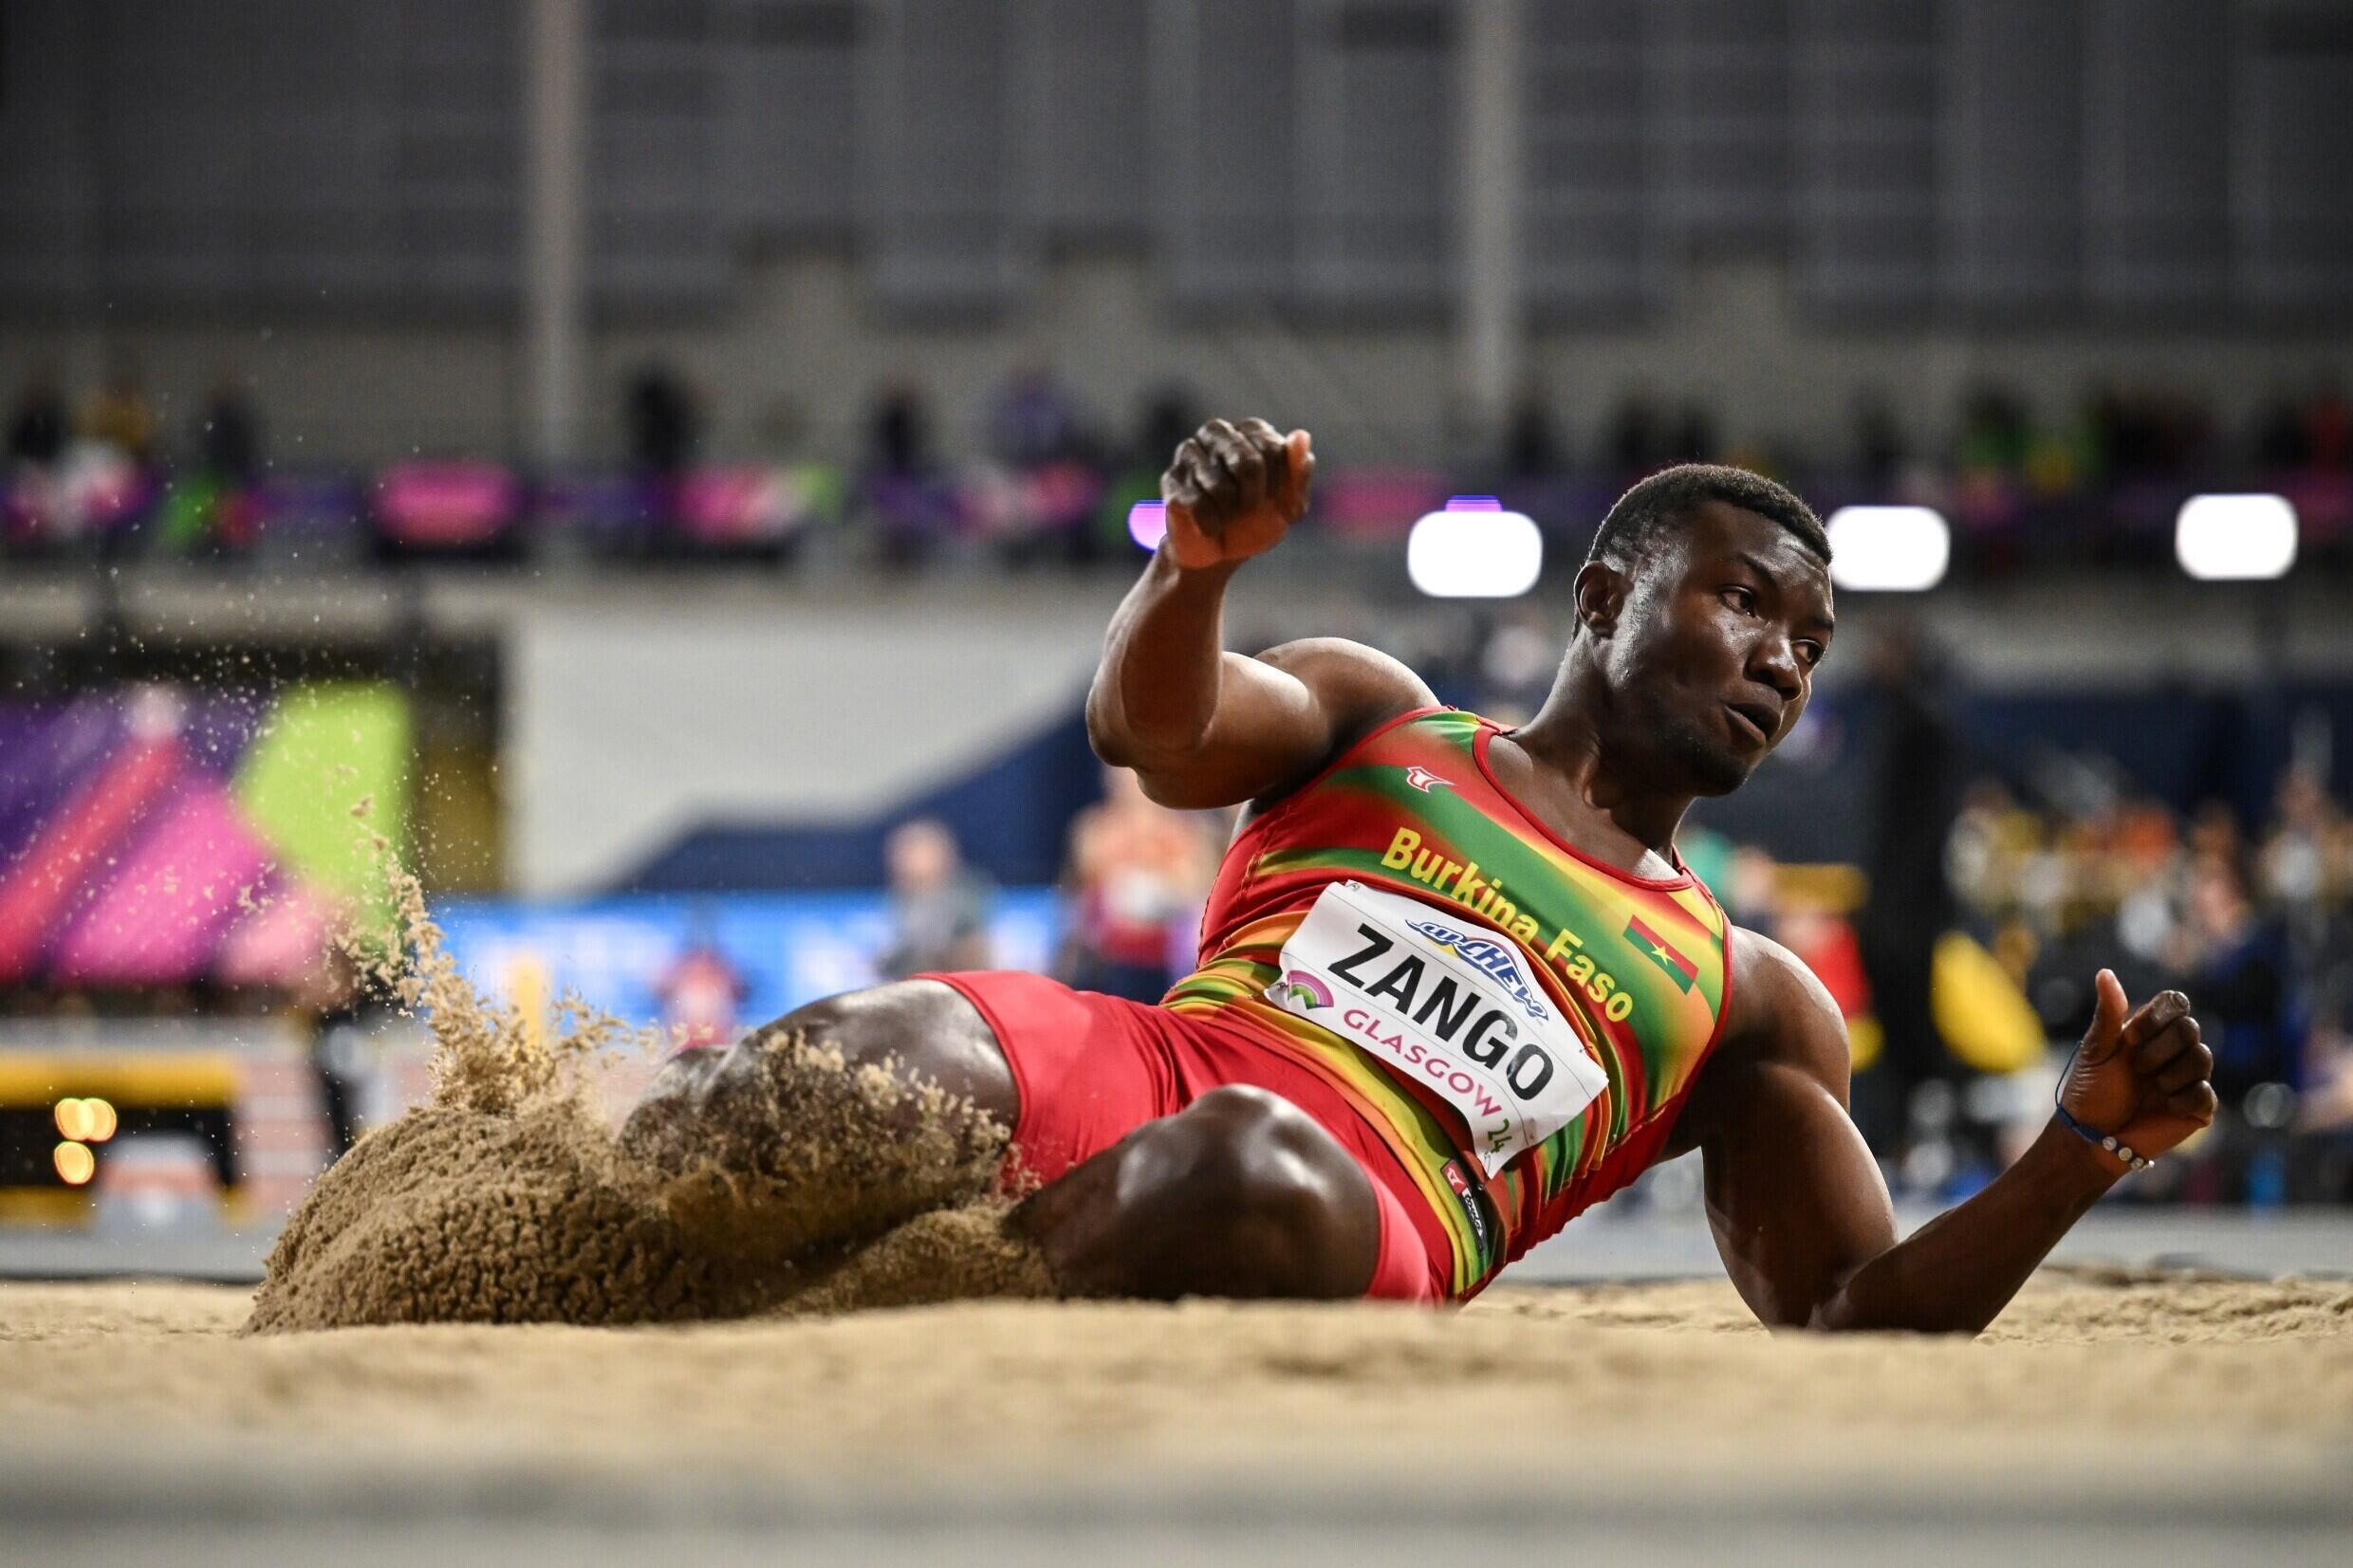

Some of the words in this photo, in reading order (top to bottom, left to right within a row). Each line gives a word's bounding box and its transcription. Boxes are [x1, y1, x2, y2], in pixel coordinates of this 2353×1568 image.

[1327, 922, 1554, 1101] ZANGO
[1380, 826, 1540, 944] Burkina
[1544, 928, 1633, 1023] Faso
[1343, 1009, 1502, 1117] GLASGOW
[1487, 1117, 1512, 1153] 24
